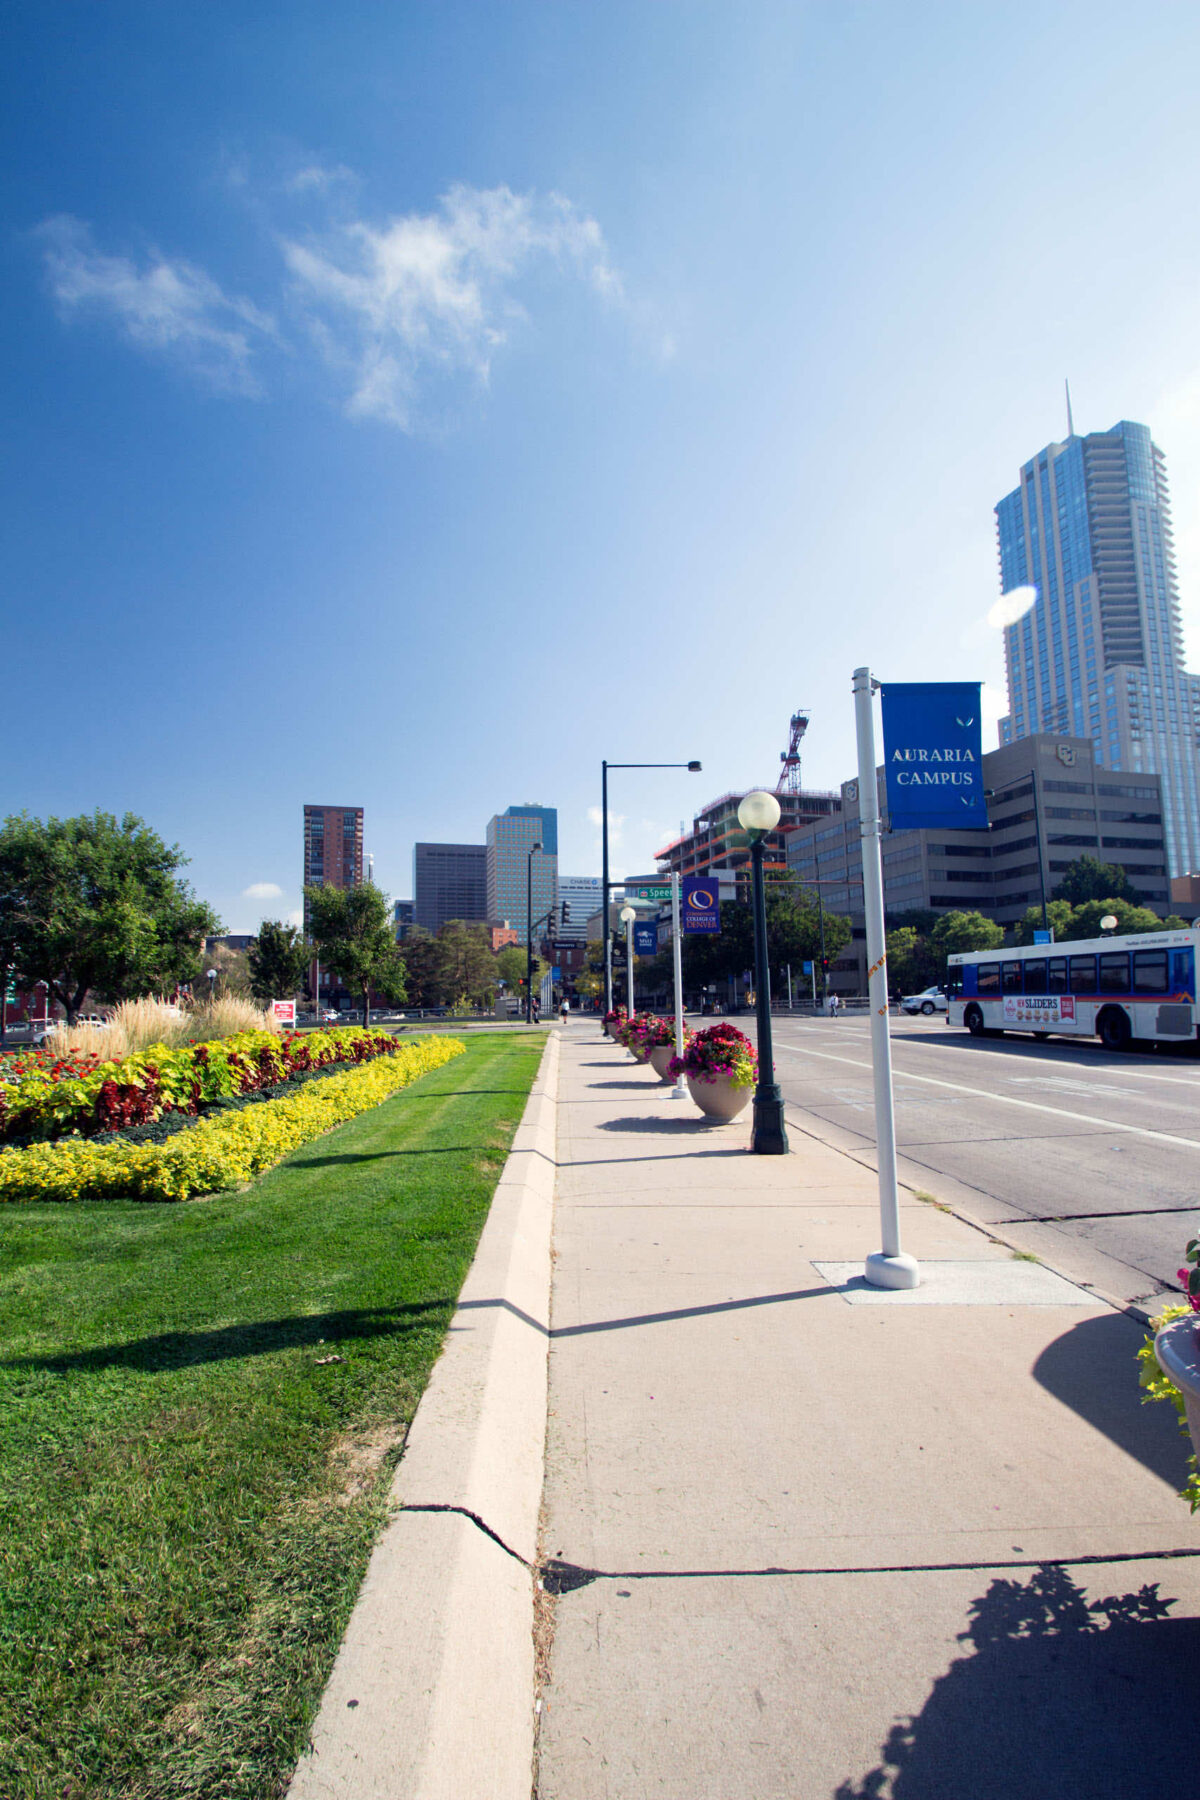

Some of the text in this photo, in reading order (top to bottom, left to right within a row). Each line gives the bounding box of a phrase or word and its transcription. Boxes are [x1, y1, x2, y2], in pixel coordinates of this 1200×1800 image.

[892, 749, 975, 762] AURARIA
[897, 772, 974, 785] CAMPUS
[649, 889, 673, 899] Speer
[1025, 998, 1058, 1009] SLIDERS
